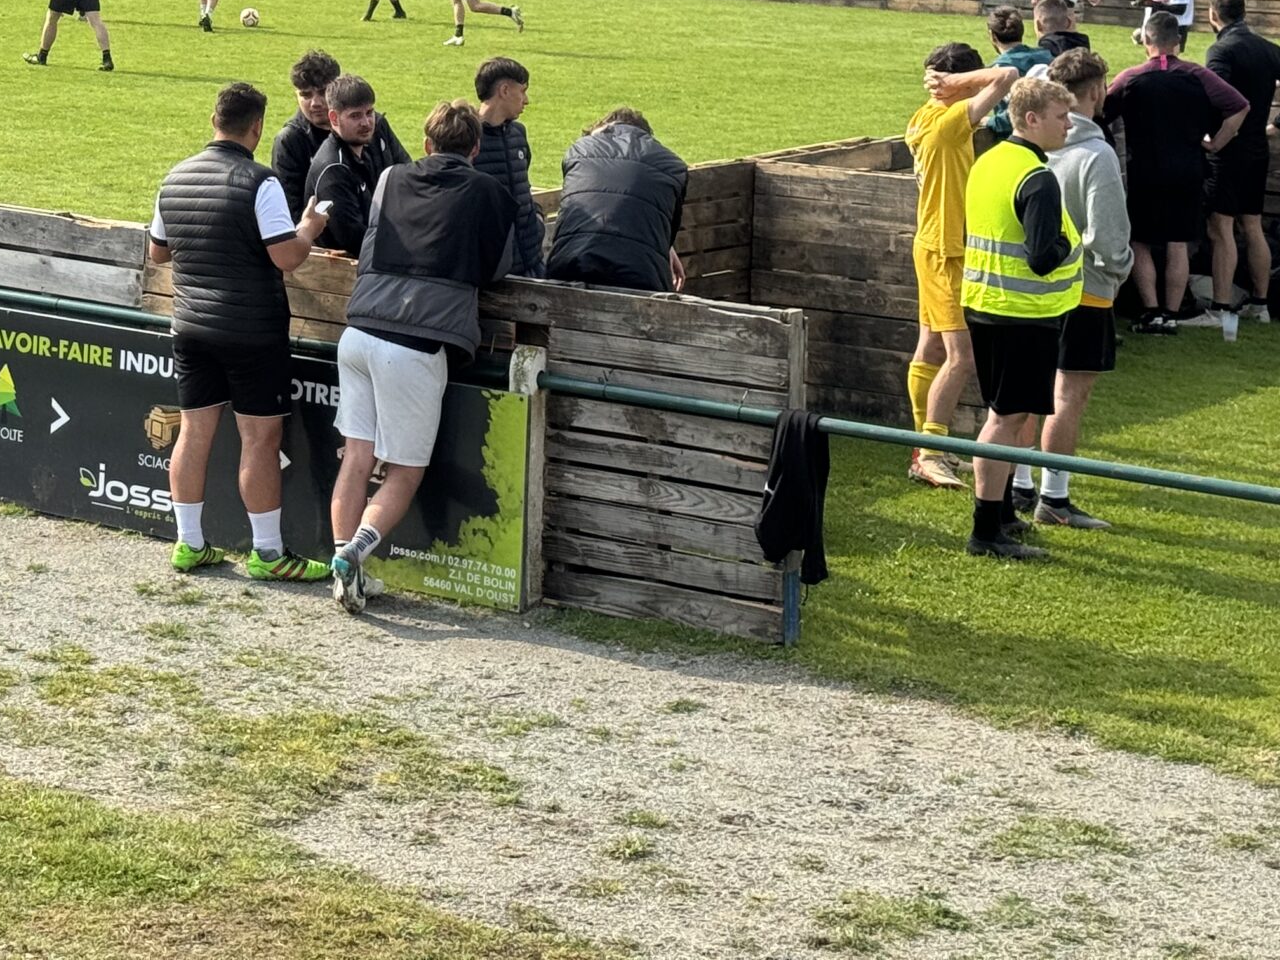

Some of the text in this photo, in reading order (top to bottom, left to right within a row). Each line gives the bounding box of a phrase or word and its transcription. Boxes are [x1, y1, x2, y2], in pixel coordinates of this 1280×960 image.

[120, 349, 178, 380] INDU
[126, 506, 161, 520] l'esprit
[389, 543, 440, 563] josso.com
[448, 555, 516, 579] 02.97.74.70.00
[423, 576, 516, 604] 56460 VAL D'OUST
[448, 568, 516, 592] Z.I. DE BOLIN
